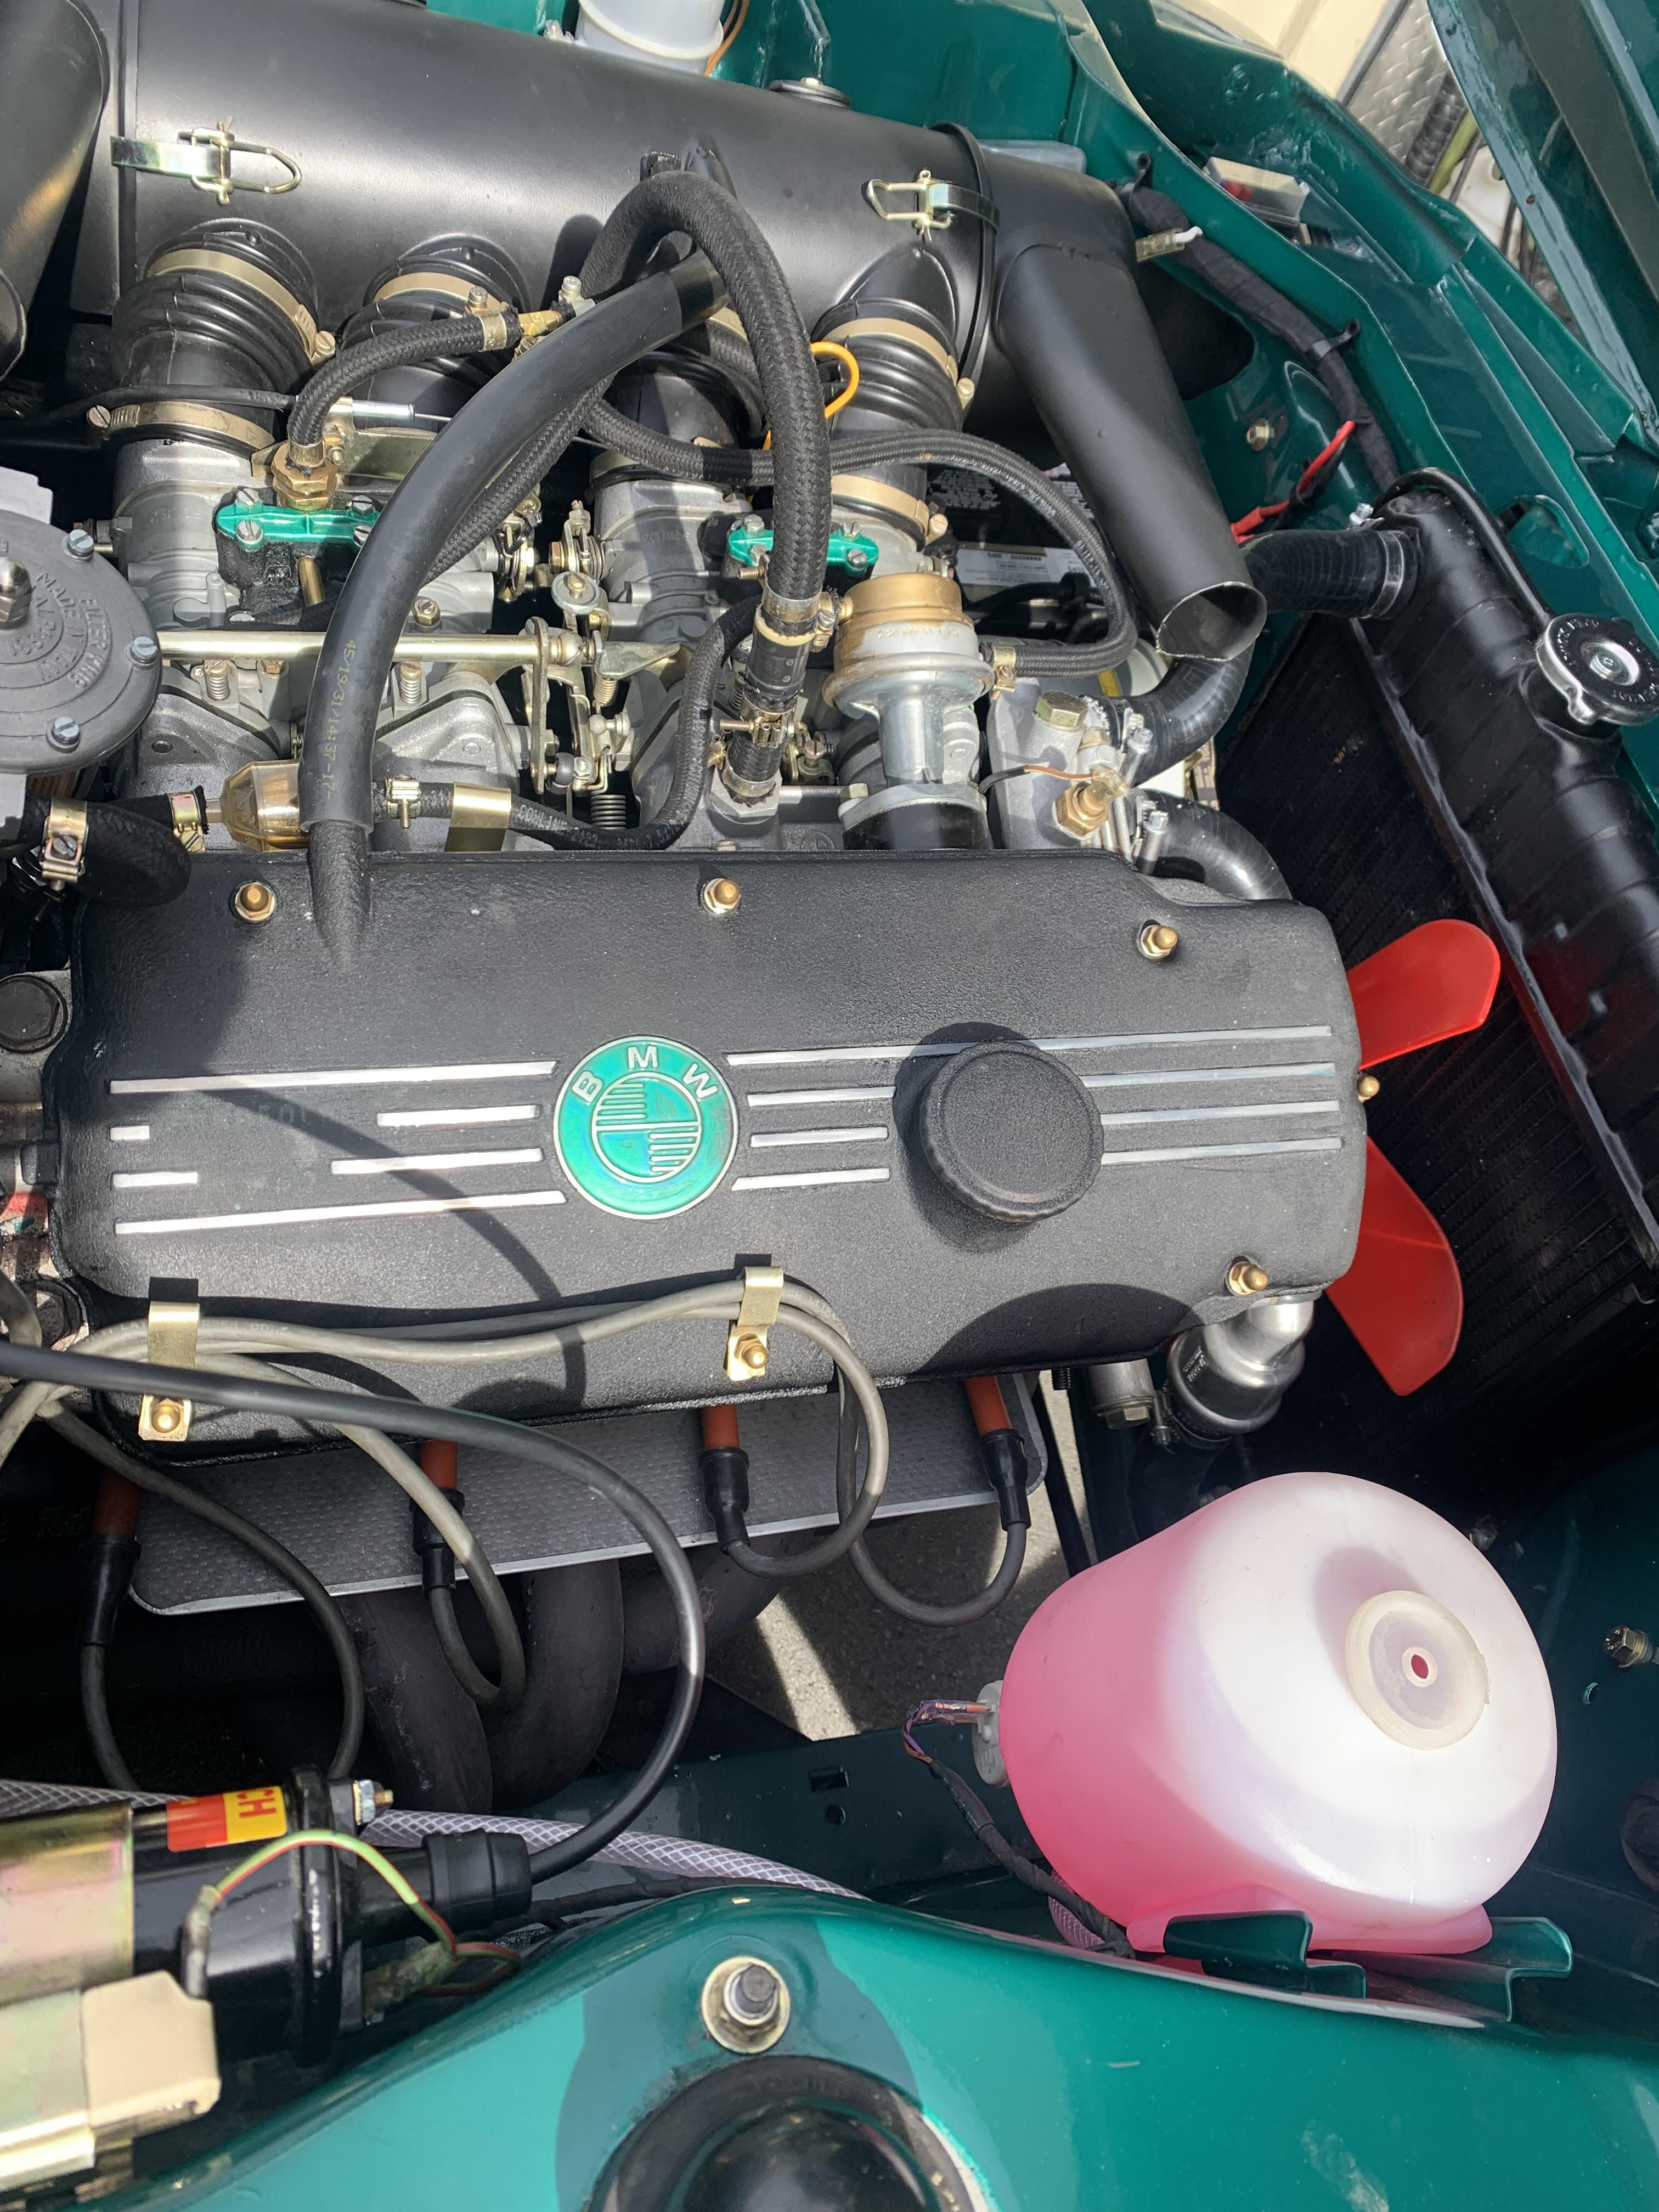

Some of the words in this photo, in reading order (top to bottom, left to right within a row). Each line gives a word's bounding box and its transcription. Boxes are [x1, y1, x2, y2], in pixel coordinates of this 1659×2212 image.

[149, 508, 204, 523] SOLEX
[8, 585, 56, 656] ALPASSI
[78, 599, 109, 651] FILTER
[572, 1045, 719, 1104] BMW
